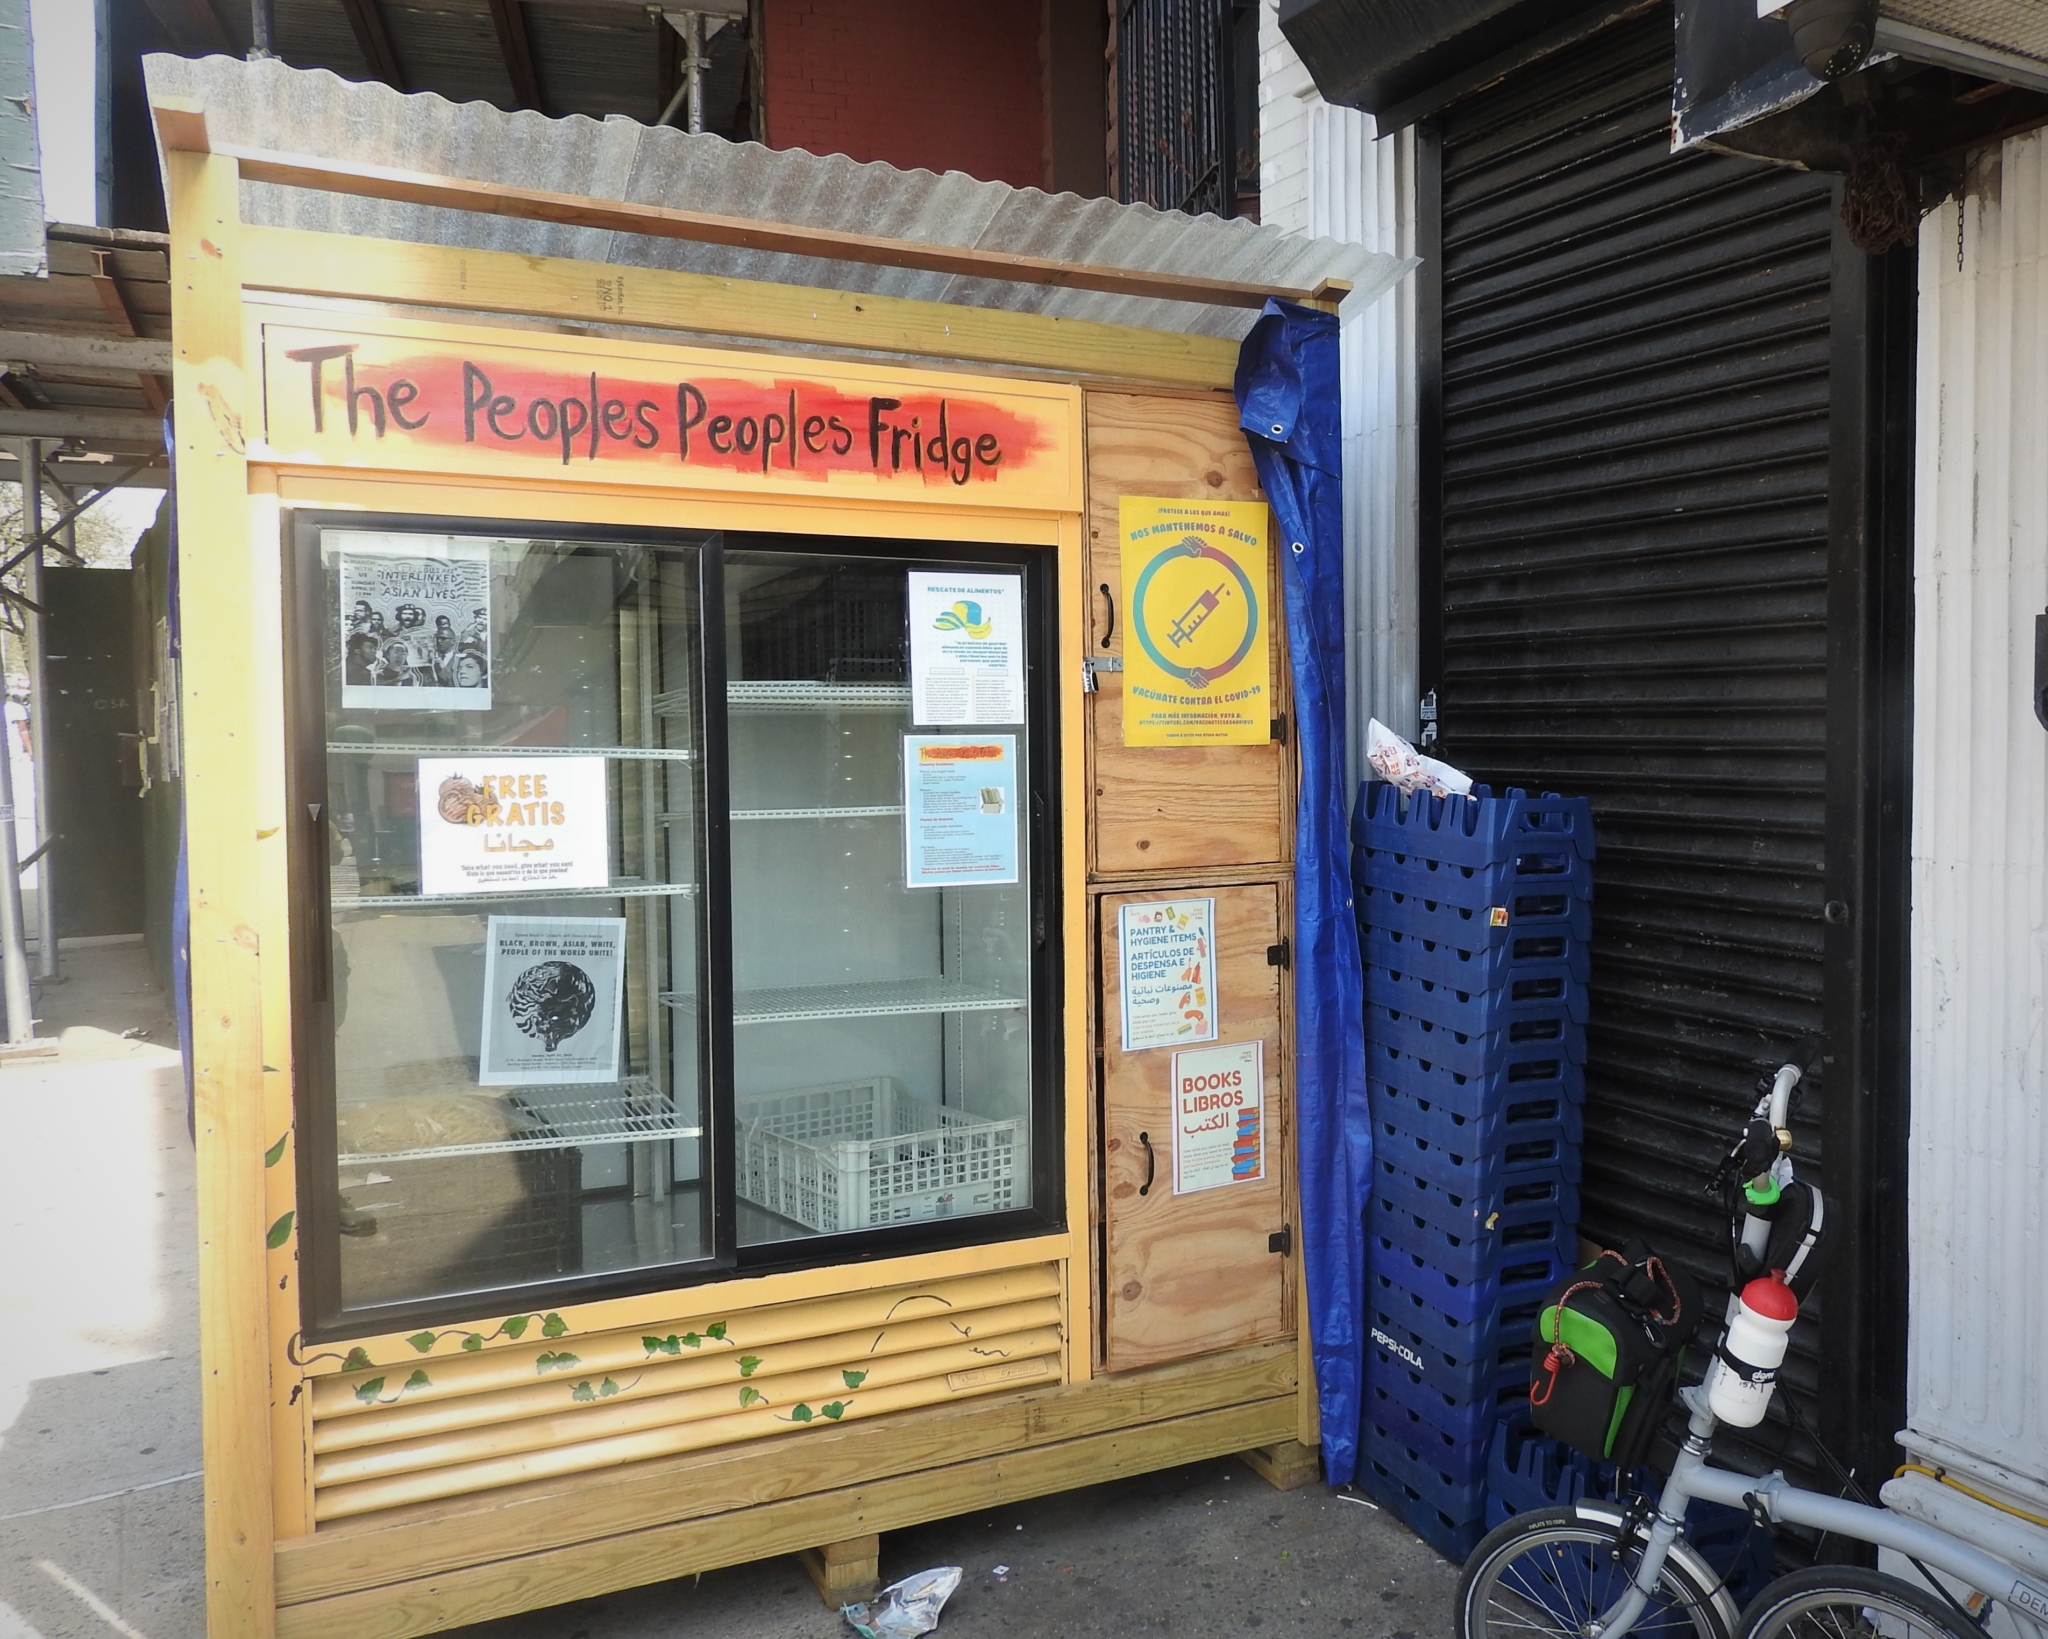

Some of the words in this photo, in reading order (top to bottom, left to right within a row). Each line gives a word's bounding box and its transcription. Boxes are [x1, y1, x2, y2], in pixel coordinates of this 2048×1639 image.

[285, 343, 430, 438] The
[462, 360, 660, 465] Peoples
[677, 382, 852, 474] Peoples
[868, 396, 1001, 486] Fridge
[1130, 527, 1150, 542] NOS
[1151, 522, 1216, 535] MANTENEMOS
[1218, 526, 1225, 535] A
[1227, 528, 1257, 546] SALVO
[381, 571, 458, 583] INTERLINKED
[381, 587, 421, 599] ASIAN
[425, 588, 456, 600] LIVES
[1132, 685, 1177, 704] VACÚNATE
[1179, 696, 1213, 706] CONTRA
[1214, 696, 1223, 705] EL
[1224, 685, 1261, 703] COVID-19
[1168, 711, 1180, 719] MÁS
[482, 774, 548, 800] FREE
[466, 801, 565, 827] GRATIS
[1130, 926, 1167, 937] PANTRY
[1168, 925, 1175, 933] &
[499, 940, 526, 948] BLACK,
[529, 940, 560, 948] BROWN,
[563, 941, 588, 949] ASIAN,
[591, 941, 616, 949] WHITE,
[1130, 935, 1169, 947] HYGIENE
[1170, 932, 1197, 943] ITEMS
[588, 949, 613, 957] UNITE!
[1131, 948, 1181, 962] ARTÍCULOS
[1183, 947, 1195, 956] DE
[1131, 959, 1177, 971] DESPENSA
[1179, 958, 1185, 966] E
[1131, 969, 1167, 981] HIGIENE
[1182, 1070, 1242, 1094] BOOKS
[1183, 1089, 1244, 1114] LIBROS
[1183, 1112, 1229, 1138] الكتب
[1370, 1327, 1425, 1371] PEPSI-COLA
